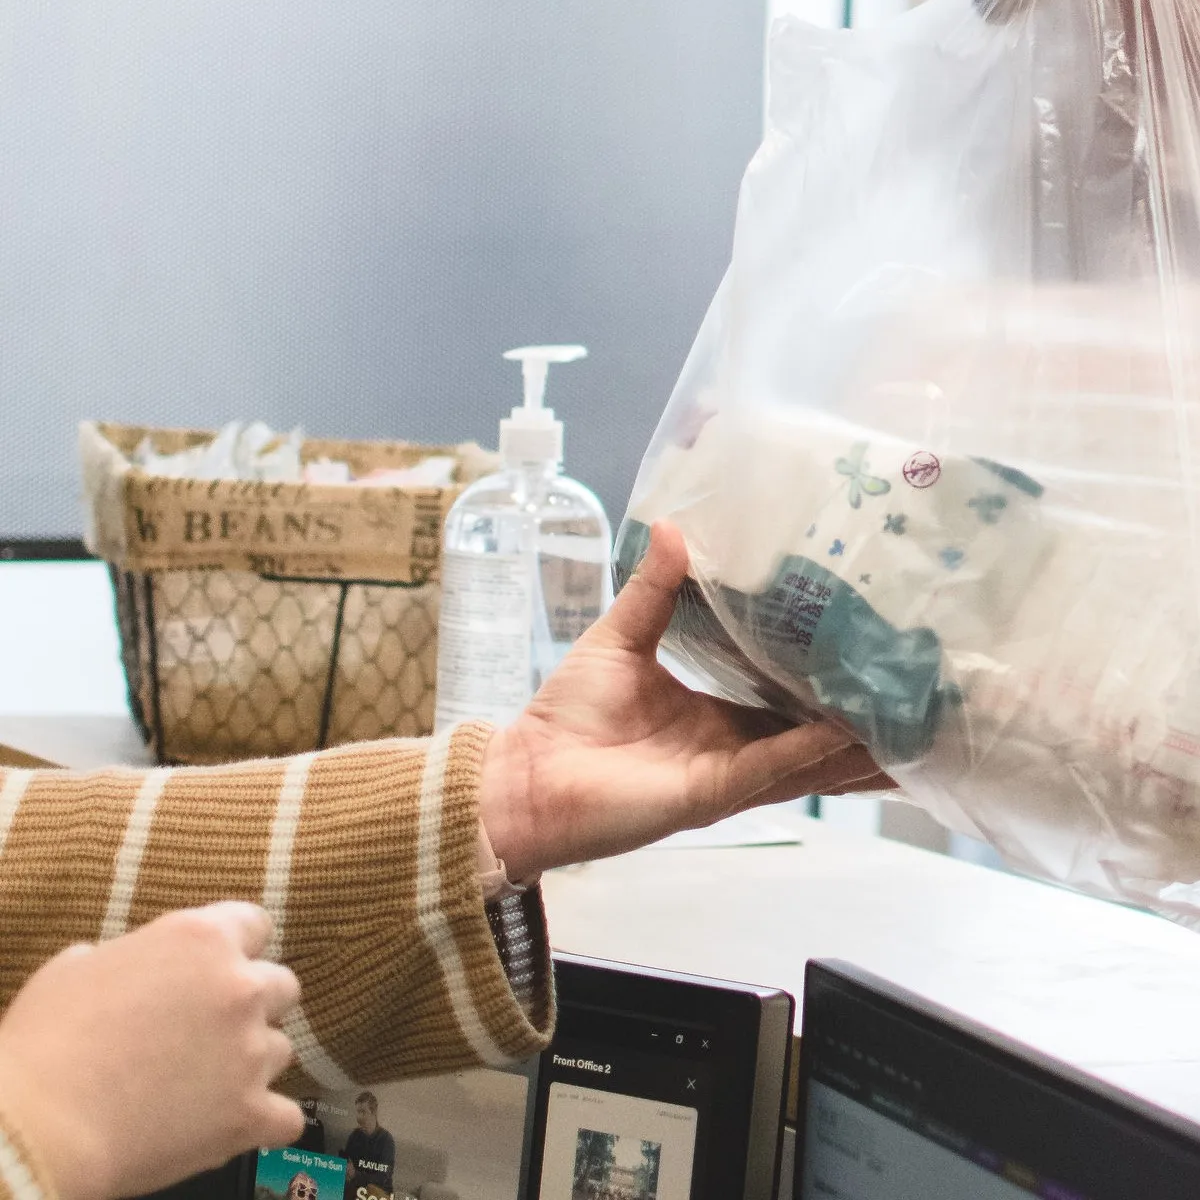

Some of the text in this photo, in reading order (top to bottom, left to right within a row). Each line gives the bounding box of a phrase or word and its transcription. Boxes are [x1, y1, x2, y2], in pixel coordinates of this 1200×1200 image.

[184, 509, 342, 544] BEANS
[553, 1054, 612, 1074] Front Office 2
[282, 1150, 343, 1171] Soak Up The Sun
[358, 1159, 389, 1173] PLAYLIST
